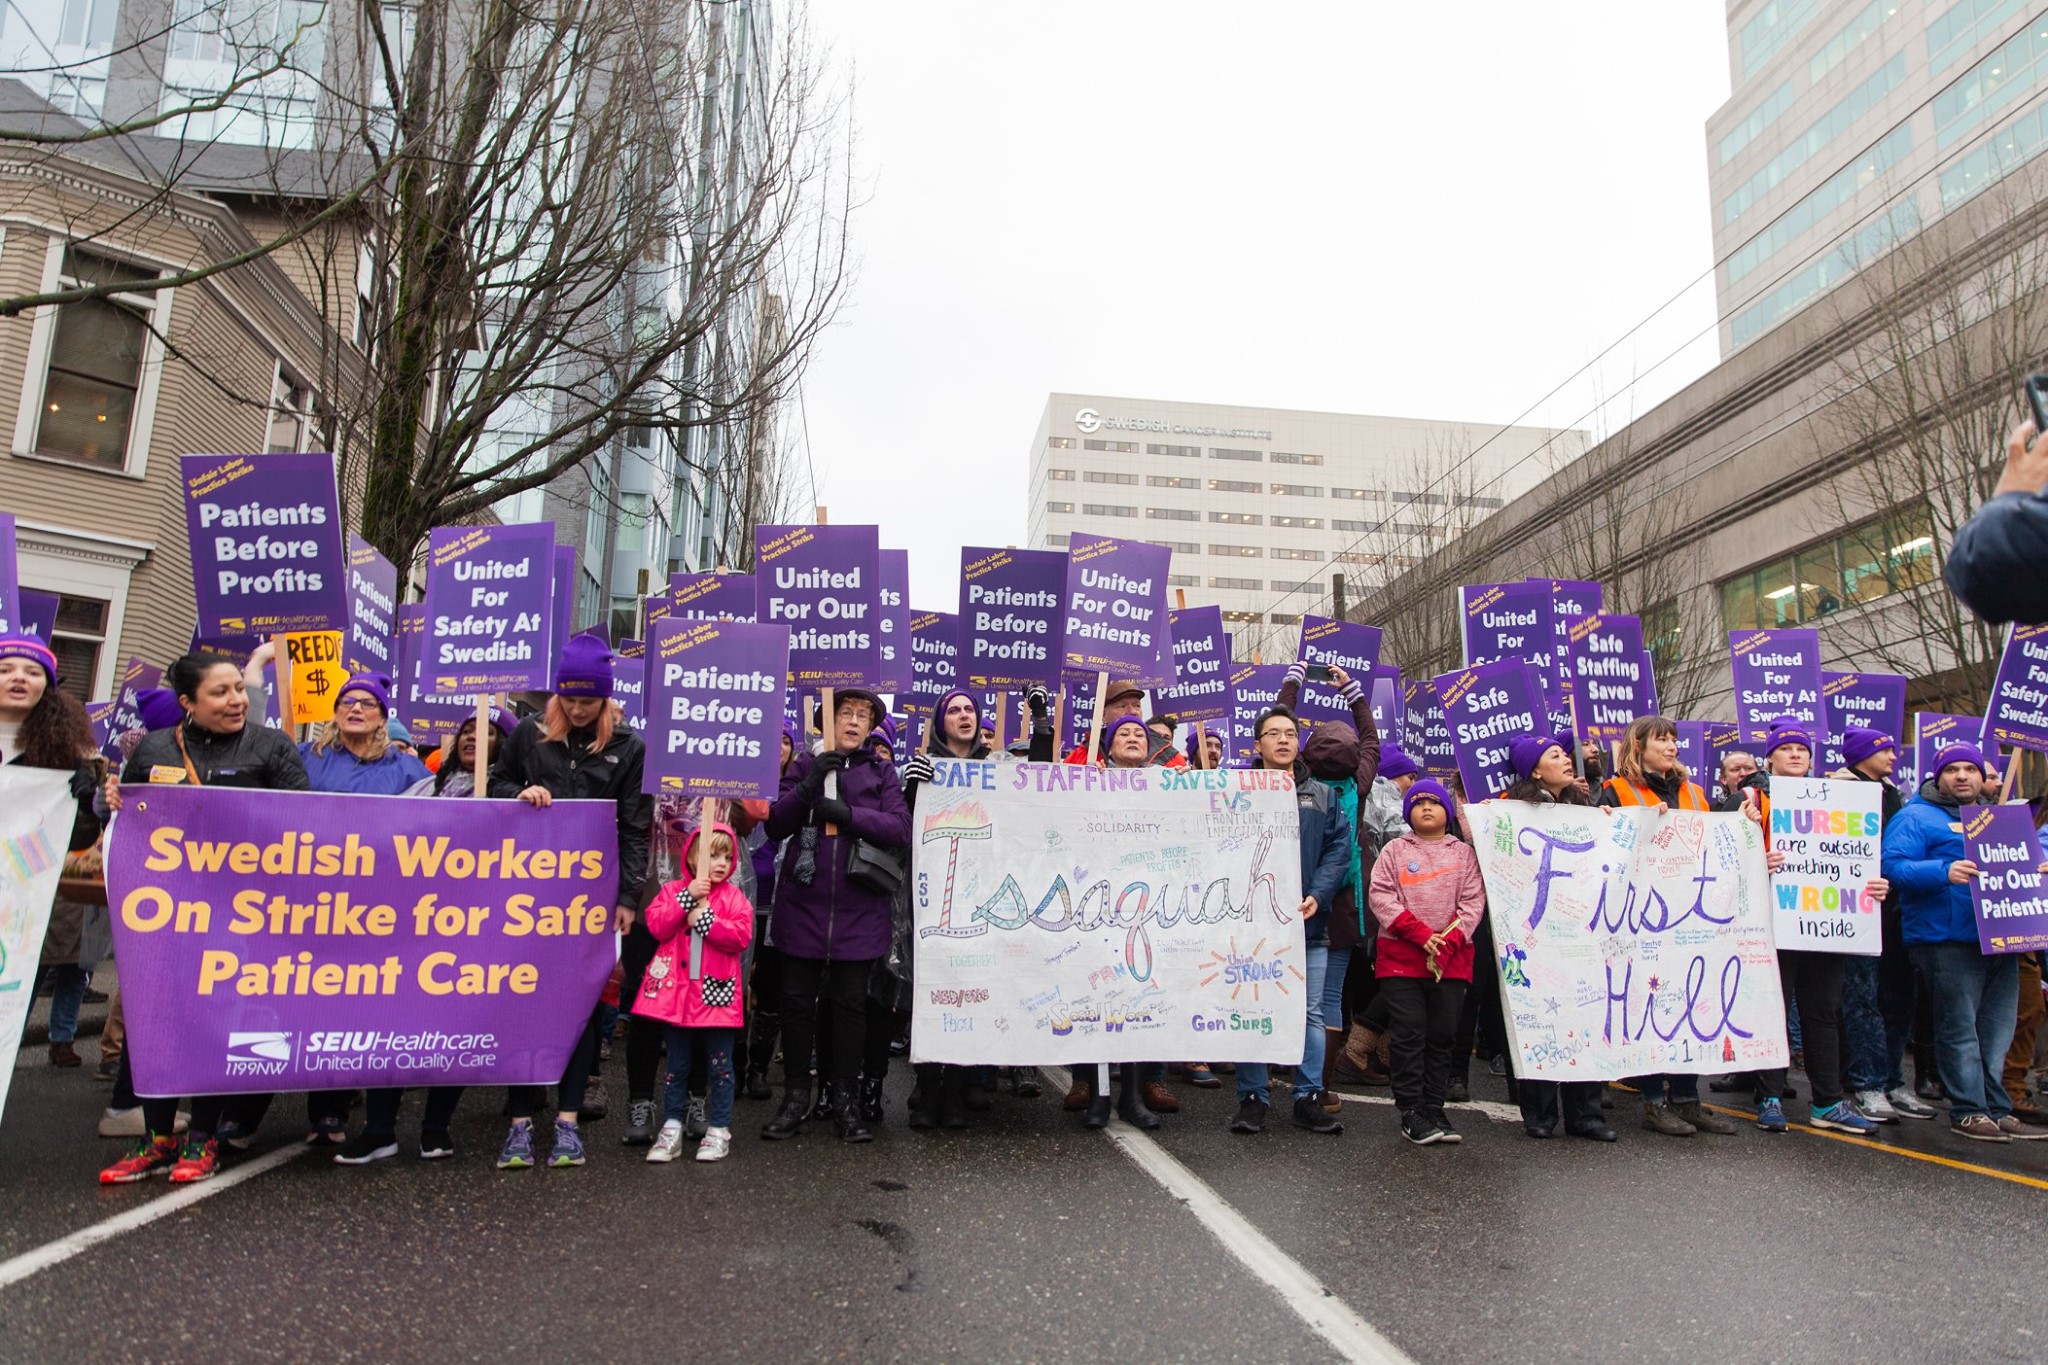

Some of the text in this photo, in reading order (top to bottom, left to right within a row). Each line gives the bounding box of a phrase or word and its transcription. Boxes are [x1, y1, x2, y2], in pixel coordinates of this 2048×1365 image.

[1105, 415, 1170, 434] SWEDISH
[199, 501, 327, 528] Patients
[215, 535, 318, 561] Before
[434, 528, 484, 557] Unfair Labor
[434, 534, 491, 567] Practice Strike
[760, 526, 807, 553] Unfair Labor
[761, 532, 815, 563] Practice Strike
[1072, 538, 1114, 556] Unfair Labor
[965, 550, 1006, 572] Unfair Labor
[1072, 545, 1119, 564] Practice Strike
[454, 557, 529, 581] United
[775, 567, 861, 589] United
[966, 556, 1012, 580] Practice Strike
[218, 568, 323, 595] Profits
[352, 570, 393, 615] Patients
[674, 576, 715, 598] Unfair Labor
[675, 581, 721, 606] Practice Strike
[1081, 569, 1152, 596] United
[471, 587, 509, 607] For
[969, 584, 1057, 607] Patients
[1071, 593, 1153, 622] For Our
[1468, 586, 1499, 609] Unfair Labor
[1469, 591, 1505, 617] Practice Strike
[354, 598, 389, 636] Before
[769, 597, 868, 619] For Our
[1482, 610, 1537, 628] United
[434, 612, 541, 639] Safety At
[975, 612, 1047, 633] Before
[1066, 617, 1151, 647] Patients
[353, 623, 388, 661] Profits
[660, 623, 712, 648] Unfair Labor
[660, 641, 694, 659] Practice
[694, 629, 720, 645] Strike
[789, 628, 871, 650] atients
[912, 637, 957, 657] Unite
[1172, 636, 1213, 655] nited
[1497, 634, 1525, 648] For
[1588, 633, 1623, 653] Safe
[287, 636, 335, 664] REED
[438, 640, 531, 664] Swedish
[973, 639, 1047, 660] Profits
[1305, 645, 1371, 672] Patients
[1532, 652, 1551, 667] At
[1749, 653, 1802, 667] United
[664, 663, 775, 693] Patients
[1187, 659, 1220, 676] Our
[1576, 656, 1639, 682] Staffing
[1764, 672, 1790, 685] For
[306, 669, 330, 697] $
[1157, 679, 1225, 701] Patients
[1441, 671, 1472, 701] Unfair Labor
[1444, 674, 1479, 710] Practice Strike
[1588, 680, 1634, 700] Saves
[2000, 681, 2048, 708] Safety
[671, 696, 763, 724] Before
[1466, 687, 1509, 713] Safe
[1742, 690, 1817, 706] Safety At
[1834, 695, 1886, 711] United
[629, 715, 647, 730] At
[1235, 707, 1256, 719] For
[1408, 708, 1424, 727] United
[1593, 704, 1634, 724] Lives
[1846, 714, 1871, 727] For
[1999, 703, 2048, 728] Swedis
[1405, 728, 1415, 742] For
[1457, 712, 1534, 744] Staffing
[667, 730, 761, 758] Profits
[1475, 746, 1510, 768] Sav
[931, 761, 1294, 792] SAFE STAFFING SAVES LIVES
[1210, 791, 1252, 813] EVS
[1797, 783, 1830, 801] if
[1086, 822, 1162, 835] SOLIDARITY
[1772, 809, 1879, 837] NURSES
[145, 826, 603, 880] Swedish Workers
[1120, 847, 1189, 867] PATIENTS BEFORE
[1776, 838, 1873, 857] are outside
[1978, 841, 2030, 864] United
[1518, 827, 1734, 935] First
[1775, 858, 1862, 882] something is
[1978, 868, 2042, 891] For Our
[121, 886, 607, 936] On Strike for Safe
[920, 823, 1292, 982] Issaquah
[1776, 884, 1874, 914] WRONG
[1799, 917, 1855, 938] inside
[197, 950, 538, 996] Patient Care
[1224, 959, 1283, 984] STRONG
[1603, 955, 1753, 1049] Hill
[1191, 1014, 1226, 1032] Gen
[226, 1061, 288, 1076] 1199NW
[304, 1051, 496, 1073] United for Quality Care
